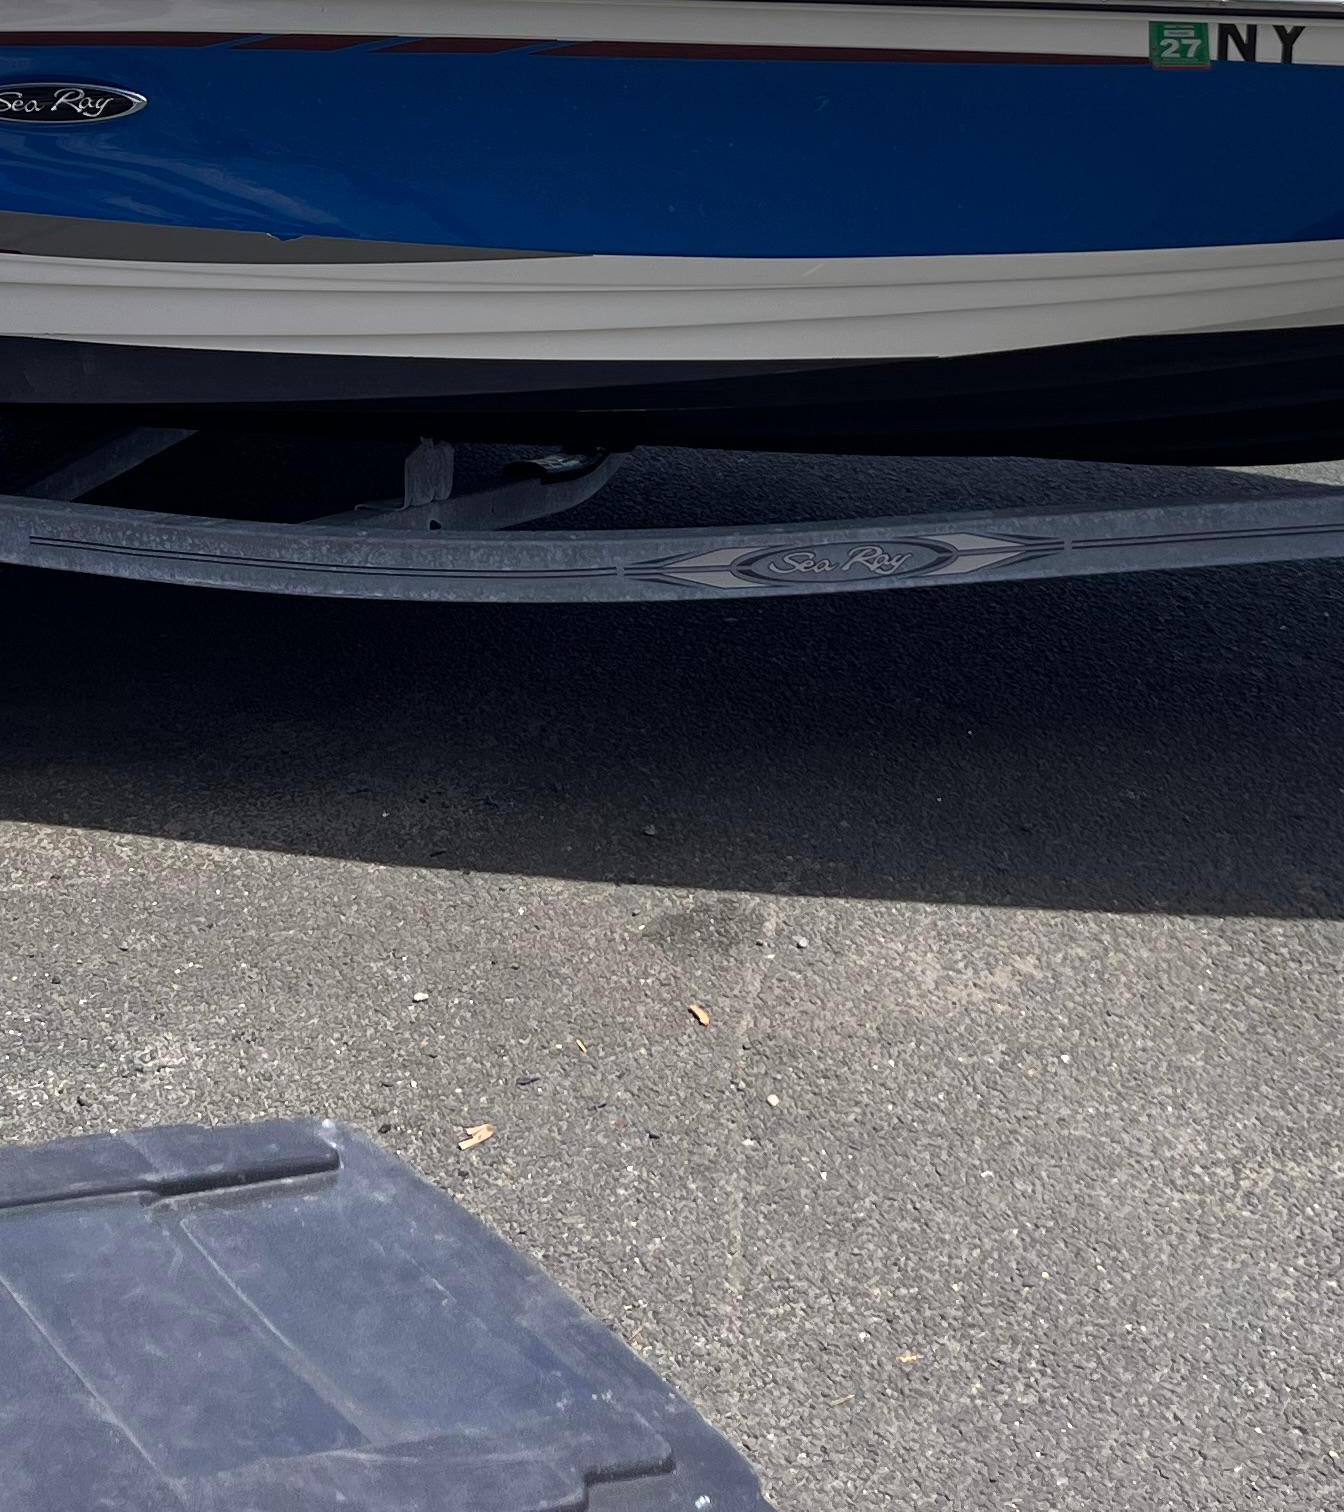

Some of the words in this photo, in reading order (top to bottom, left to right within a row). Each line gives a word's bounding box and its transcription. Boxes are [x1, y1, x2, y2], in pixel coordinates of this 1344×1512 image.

[1160, 38, 1202, 58] 27
[1218, 23, 1307, 64] NY
[50, 88, 115, 118] Ray
[769, 551, 837, 575] Sea
[840, 544, 913, 573] Ray
